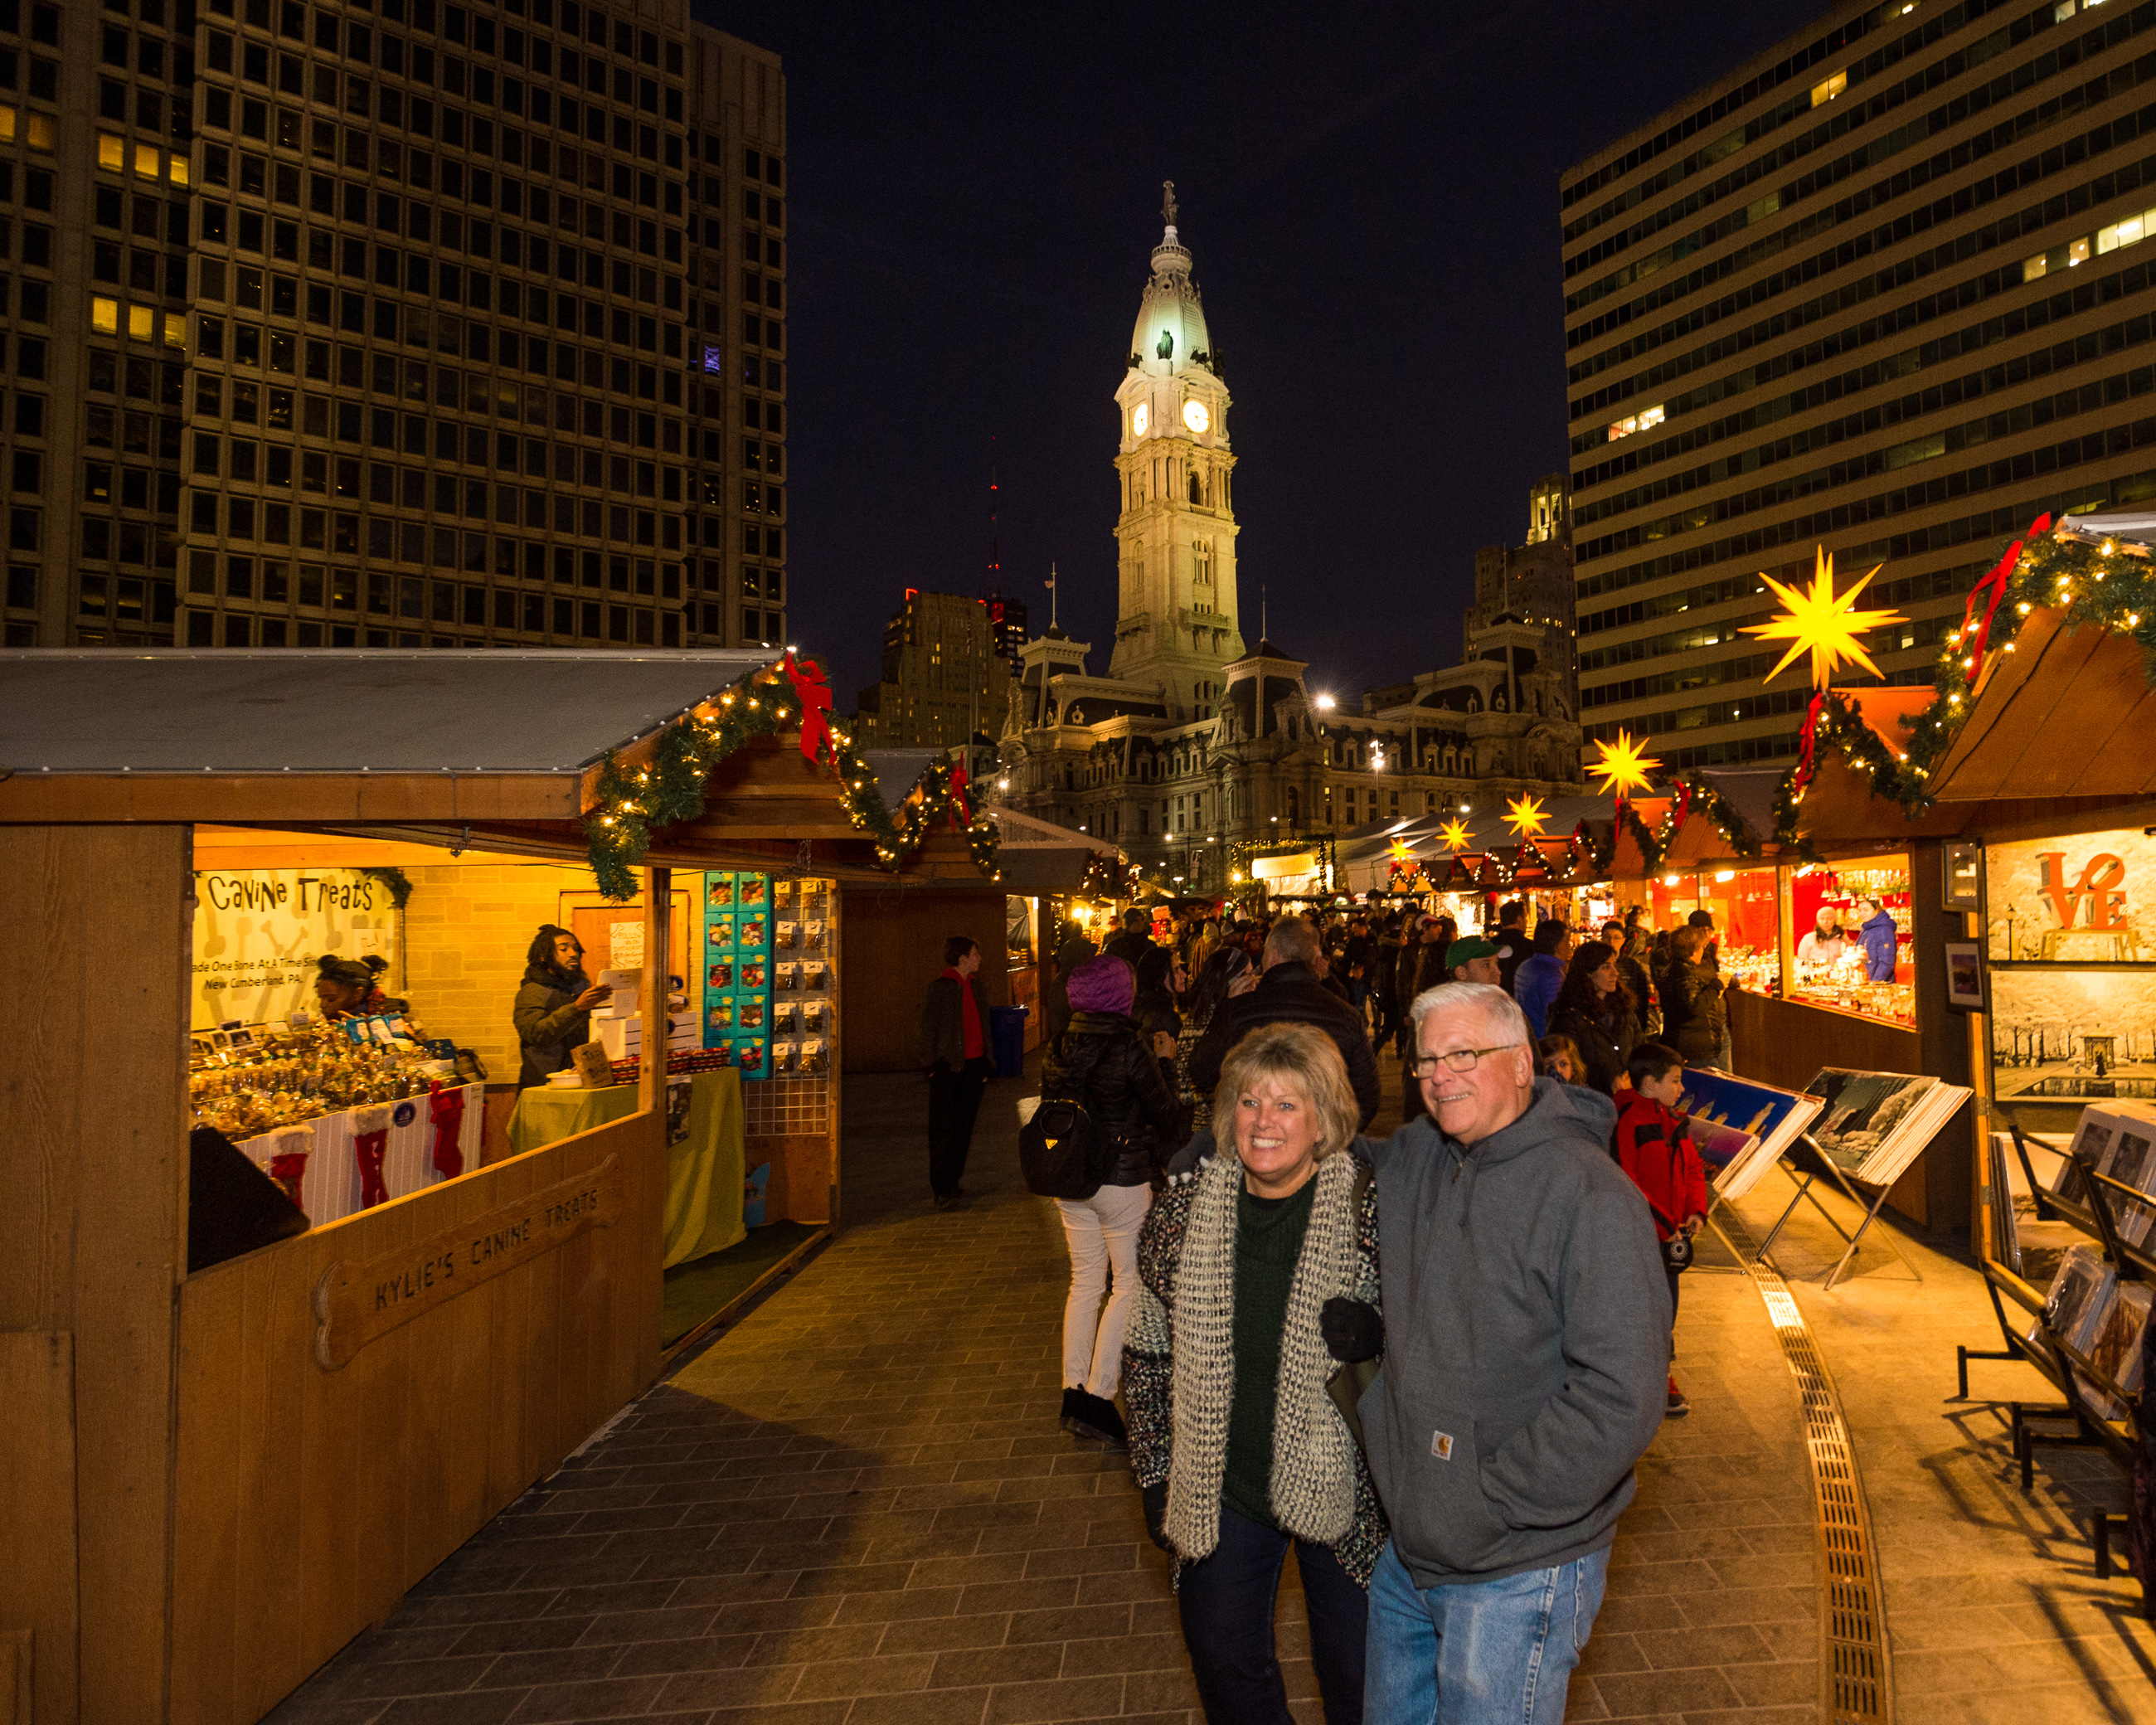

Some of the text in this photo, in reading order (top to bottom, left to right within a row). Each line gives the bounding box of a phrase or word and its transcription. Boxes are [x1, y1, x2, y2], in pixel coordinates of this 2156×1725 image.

[298, 877, 373, 912] Treats
[192, 961, 209, 973] ade
[211, 960, 232, 972] One
[234, 960, 254, 970] Bone
[279, 957, 302, 968] Time
[205, 979, 227, 990] New
[374, 1188, 598, 1311] KYLIE'S CANINE TREATS
